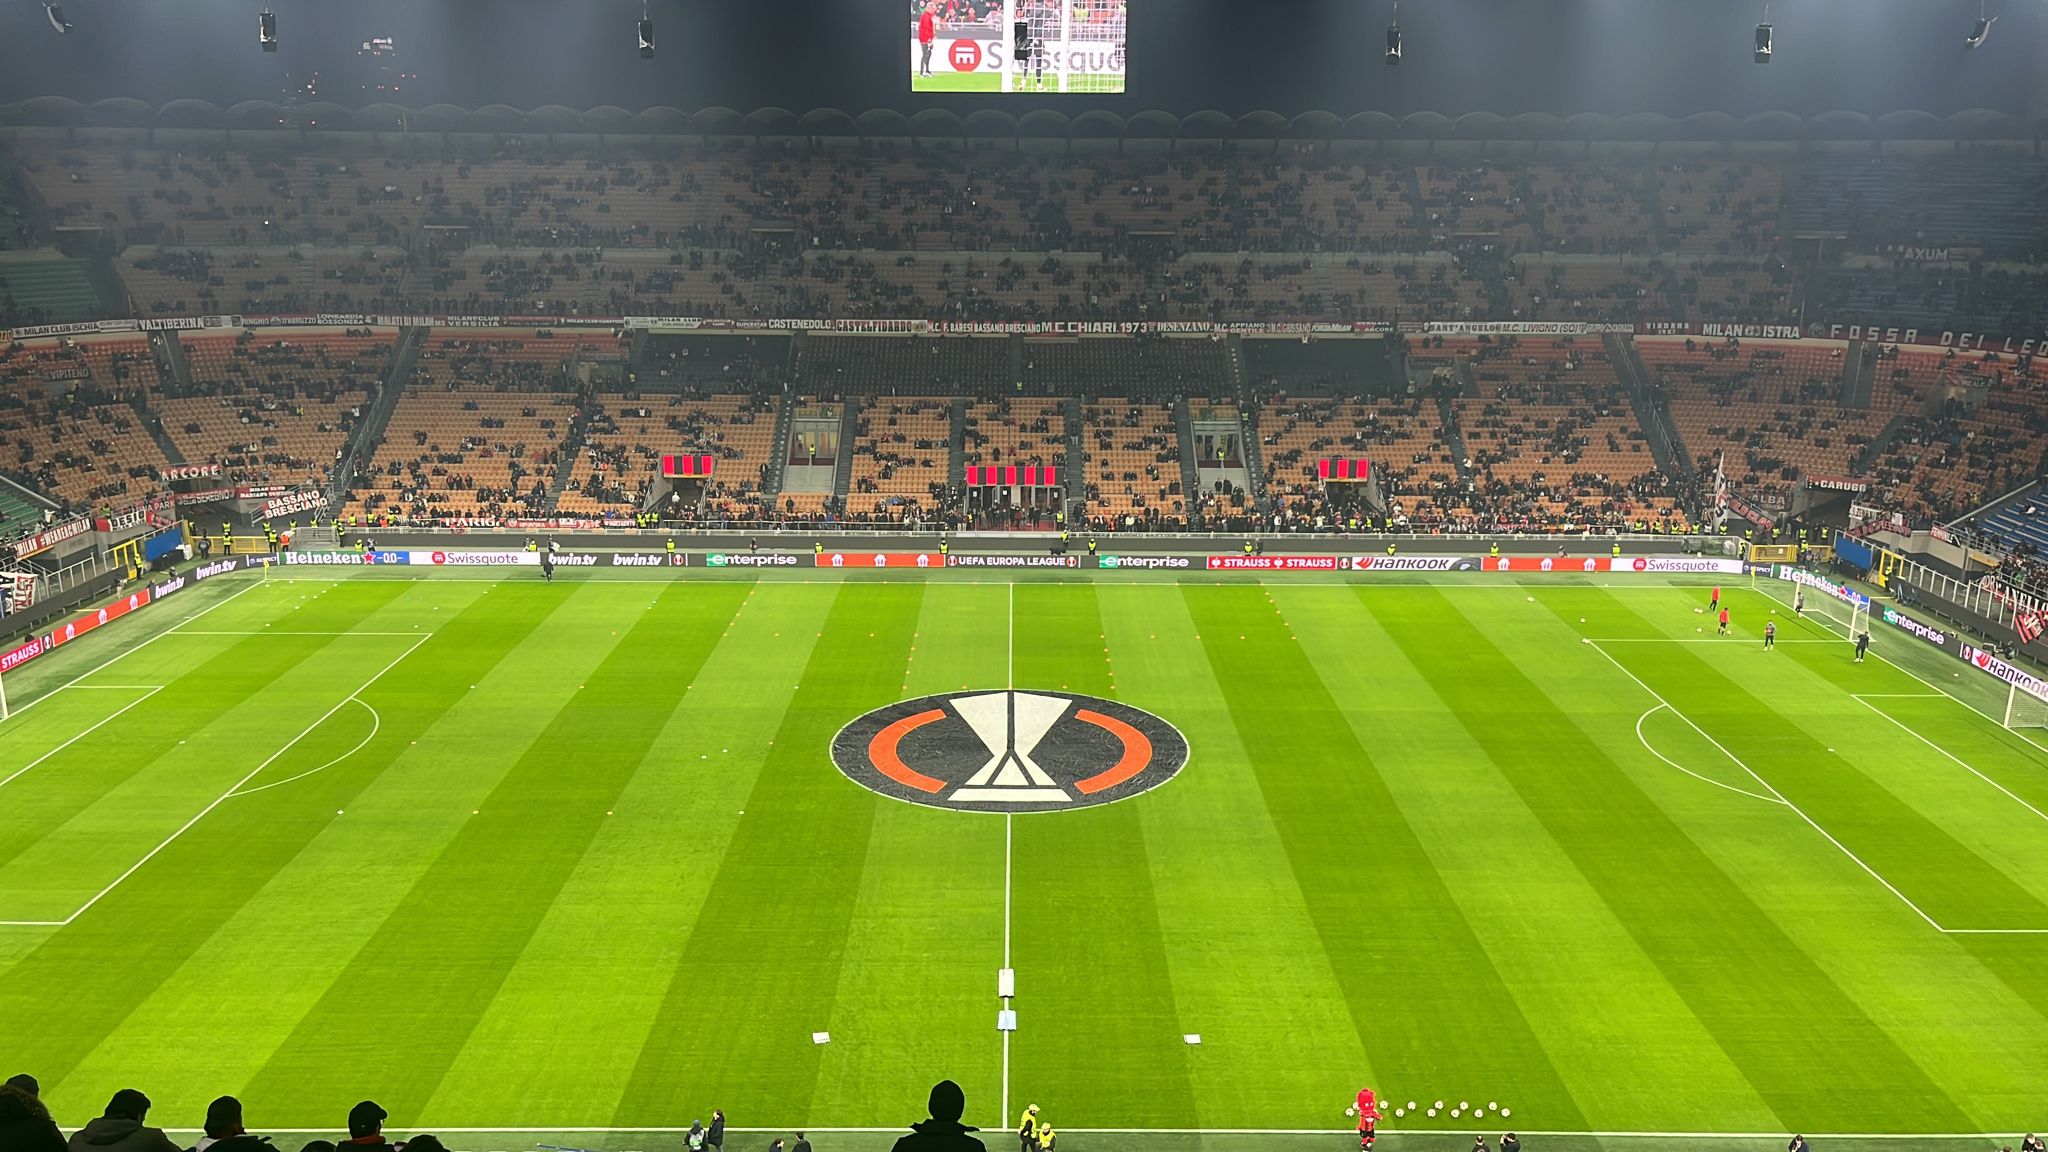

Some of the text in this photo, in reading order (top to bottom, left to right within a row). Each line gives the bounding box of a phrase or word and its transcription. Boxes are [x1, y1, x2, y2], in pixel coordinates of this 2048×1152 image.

[1905, 247, 1948, 260] AXUM
[24, 326, 50, 336] MILAN
[51, 324, 71, 333] CLUB
[72, 322, 99, 332] ISCHIA
[139, 317, 204, 331] VALTIBERINA
[768, 319, 831, 330] CASTENEDOLO
[836, 320, 912, 332] CASTELFIDARDO
[950, 322, 973, 333] BARESI
[974, 322, 1004, 333] BASSANO
[1120, 322, 1147, 333] 1973
[1157, 321, 1210, 332] DESENZANO
[1522, 323, 1558, 333] LIVIGNO
[1702, 323, 1800, 339] MILAN ISTRA
[1831, 324, 1918, 343] FOSSA
[1940, 331, 1985, 350] DEI
[50, 368, 90, 381] VIPITENO
[162, 464, 219, 481] ARCORE
[1820, 479, 1867, 494] CARUGO
[154, 500, 175, 512] PARK
[268, 490, 320, 509] BASSANO
[1752, 494, 1786, 505] ALBA
[265, 497, 328, 520] BRESCIANO
[112, 511, 144, 527] DESIO
[286, 551, 362, 565] Heineken
[447, 551, 519, 565] Swissquote
[549, 553, 598, 566] bwin.tv
[613, 553, 663, 566] bwin.tv
[712, 554, 798, 567] enterprise
[958, 557, 1066, 566] UEFA EUROPA LEAGUE
[1104, 556, 1190, 569] enterprise
[1224, 558, 1333, 568] STRAUSS STRAUSS
[196, 560, 238, 581] bwin.tv
[1648, 558, 1719, 572] Swissquote
[1885, 611, 1945, 645] enterprise
[2, 643, 40, 669] STRAUSS
